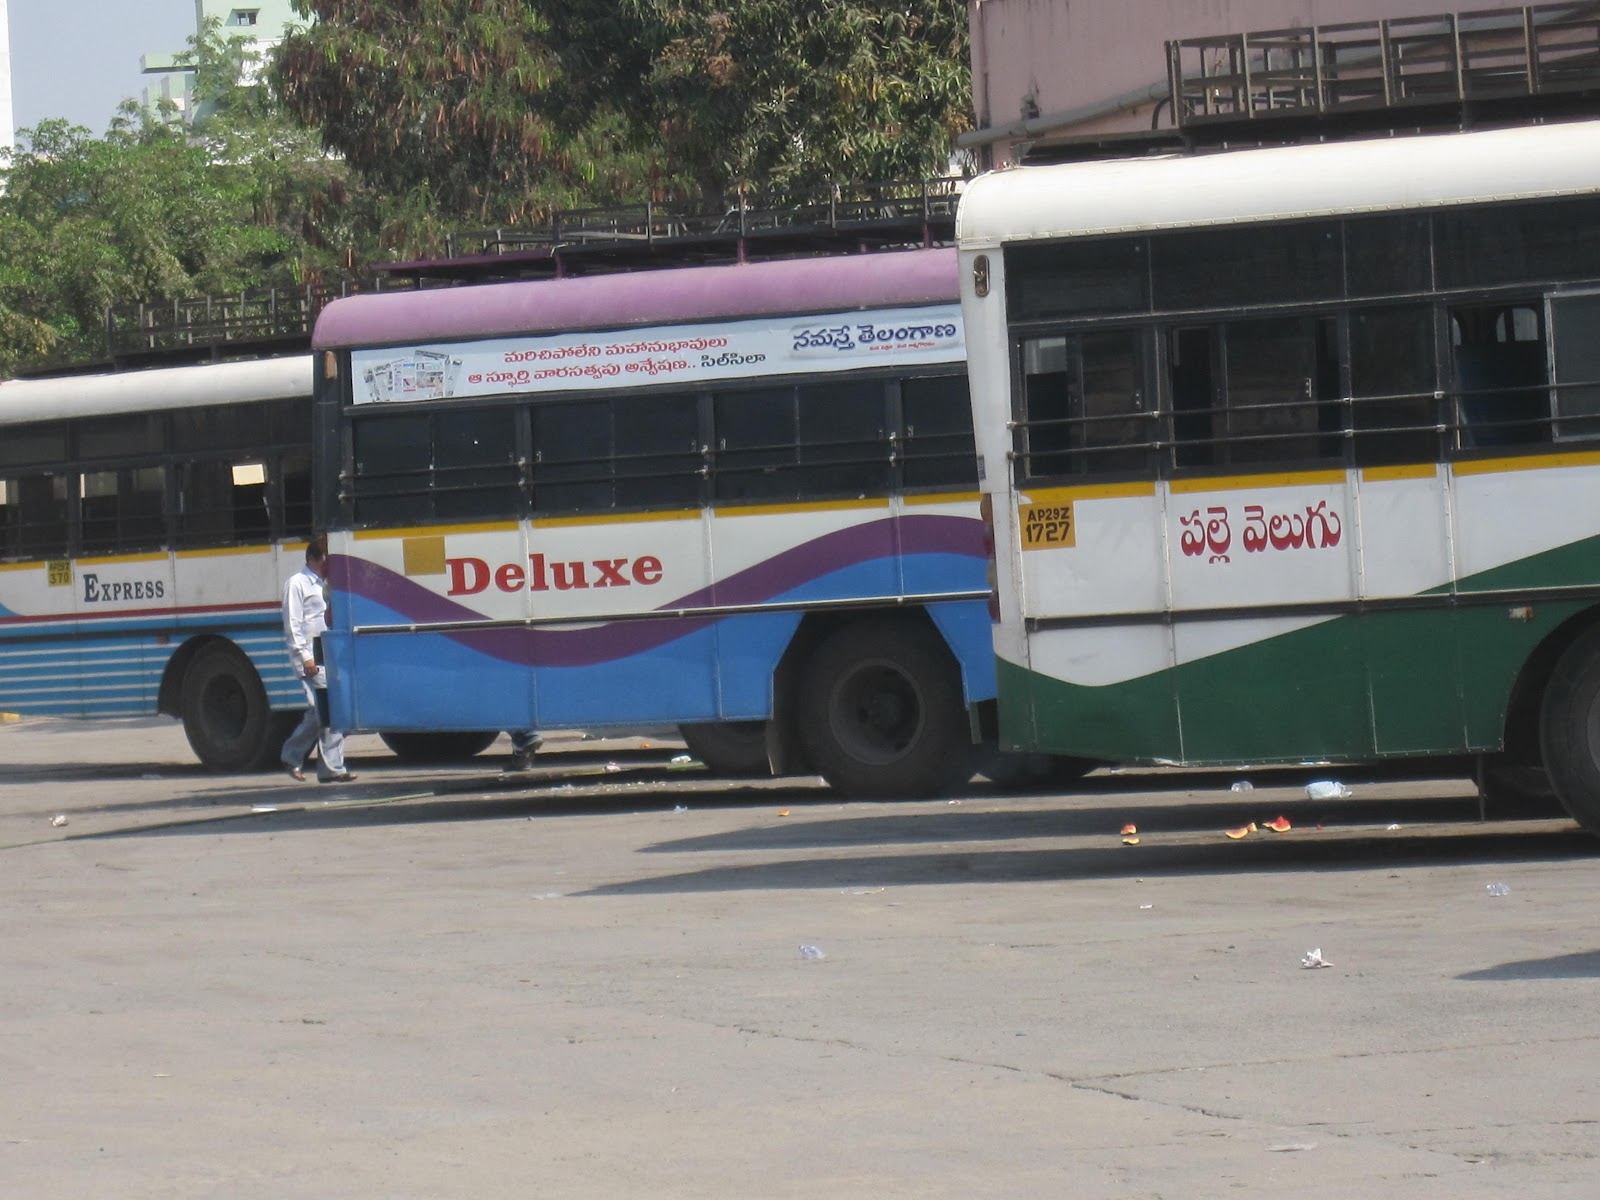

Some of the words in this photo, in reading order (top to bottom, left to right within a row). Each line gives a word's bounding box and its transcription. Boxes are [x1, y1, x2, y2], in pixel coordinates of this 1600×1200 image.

[504, 344, 601, 363] మరిచిపోలేని
[605, 336, 728, 355] మహానుభావులు
[793, 326, 855, 351] నమస్తే
[857, 323, 956, 343] తెలంగాణ
[534, 363, 621, 379] వారసత్వపు
[1027, 507, 1070, 522] AP29Z
[1026, 521, 1070, 543] 1727
[1179, 506, 1231, 564] పల్లె
[1242, 500, 1342, 553] వెలుగు
[446, 553, 664, 597] Deluxe
